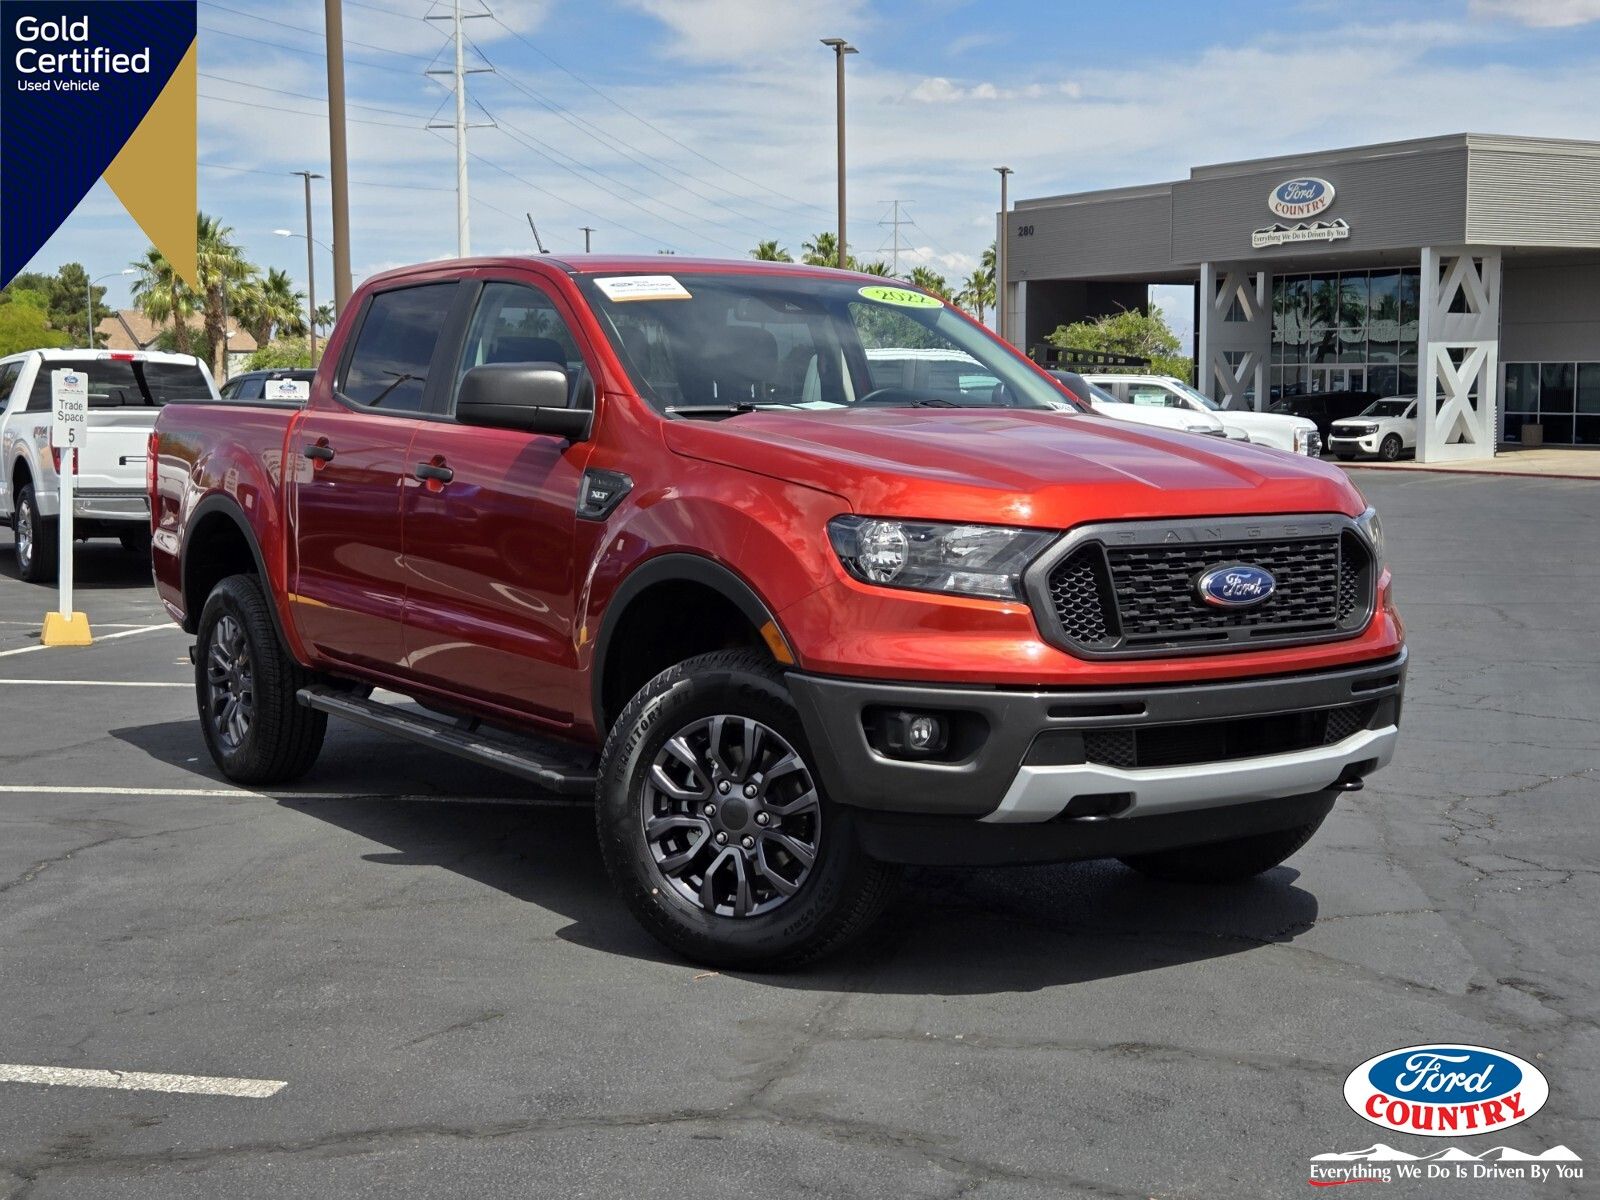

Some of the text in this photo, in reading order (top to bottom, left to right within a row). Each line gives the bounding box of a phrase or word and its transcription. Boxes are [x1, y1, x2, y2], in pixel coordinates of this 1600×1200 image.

[1284, 182, 1316, 200] Ford
[1275, 197, 1326, 215] COUNTRY
[1018, 225, 1034, 237] 280
[1292, 232, 1301, 240] Do
[1307, 230, 1326, 239] Driven
[1335, 229, 1347, 237] You
[59, 399, 83, 411] Trade
[57, 410, 84, 423] Space
[68, 428, 76, 443] 5
[591, 490, 609, 500] XLT
[1116, 523, 1333, 543] RANGER
[1223, 573, 1263, 597] Ford
